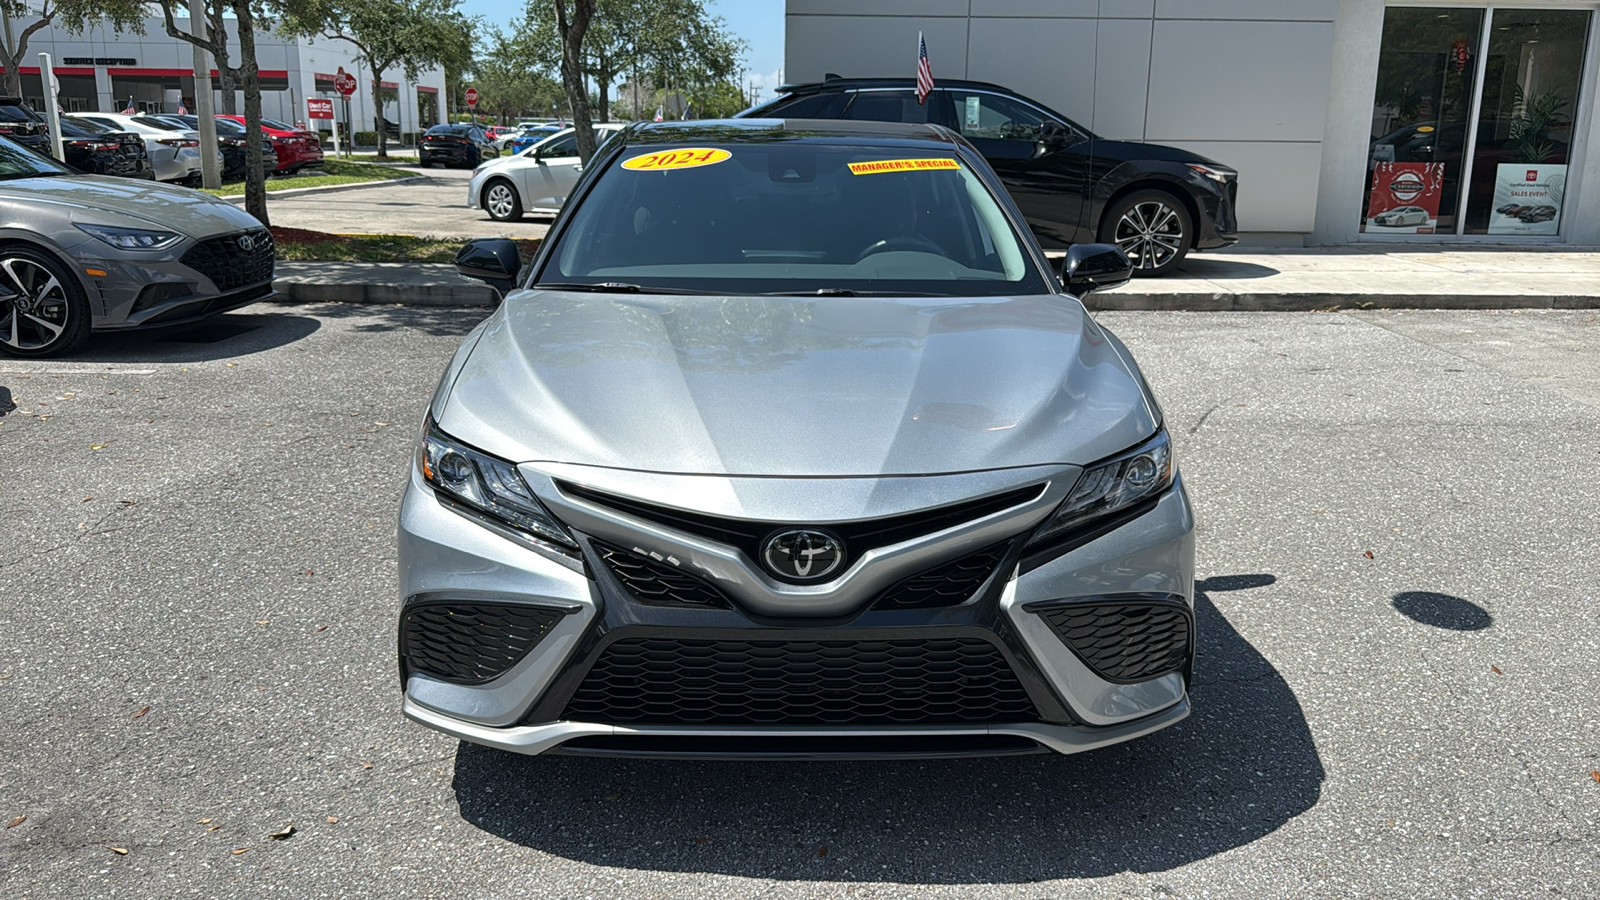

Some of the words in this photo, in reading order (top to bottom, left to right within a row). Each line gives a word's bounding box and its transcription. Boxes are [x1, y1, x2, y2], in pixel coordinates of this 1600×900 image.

[638, 150, 715, 168] 2024
[851, 161, 914, 173] MANAGER'S
[915, 160, 957, 168] SPECIAL
